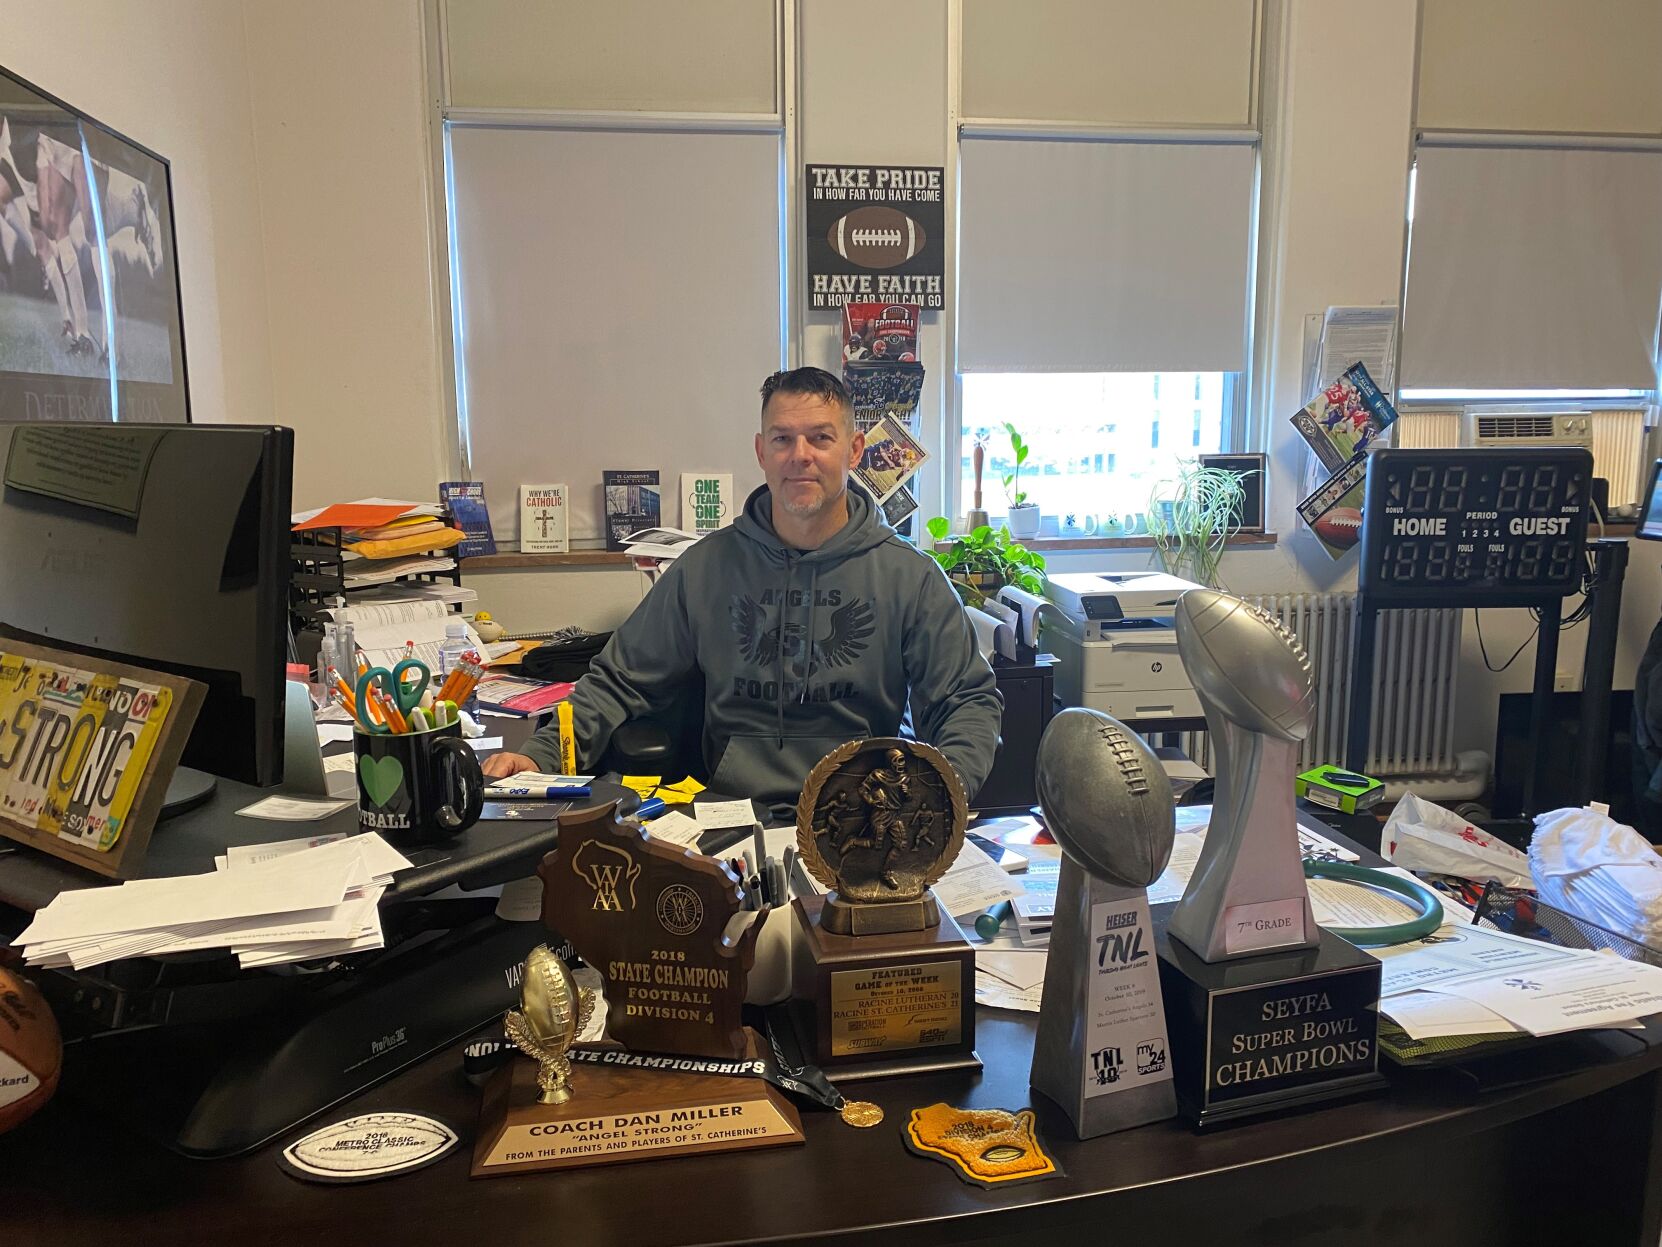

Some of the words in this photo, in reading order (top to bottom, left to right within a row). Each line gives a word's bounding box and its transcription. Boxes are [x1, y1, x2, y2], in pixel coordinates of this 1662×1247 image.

[812, 168, 871, 188] TAKE
[875, 169, 941, 189] PRIDE
[814, 188, 822, 200] IN
[826, 188, 846, 200] HOW
[849, 189, 866, 200] FAR
[869, 189, 885, 200] YOU
[888, 189, 912, 201] HAVE
[915, 190, 940, 201] COME
[813, 275, 871, 293] HAVE
[878, 275, 941, 293] FAITH
[814, 294, 824, 306] IN
[827, 294, 851, 306] HOW
[903, 294, 924, 306] CAN
[928, 295, 941, 306] GO
[695, 479, 719, 493] ONE
[527, 497, 562, 507] CATHOLIC
[695, 494, 719, 504] TEAM
[696, 505, 720, 519] ONE
[1385, 506, 1404, 514] BONUS
[1466, 511, 1498, 520] PERIOD
[1393, 518, 1447, 536] HOME
[1462, 529, 1467, 537] 1
[1509, 517, 1571, 535] GUEST
[1457, 545, 1473, 553] FOULS
[1488, 544, 1504, 552] FOULS
[1106, 911, 1138, 928] HEISER
[1255, 917, 1292, 931] GRADE
[1096, 928, 1149, 967] TNL
[651, 951, 685, 961] 2018
[609, 961, 650, 983] STATE
[655, 964, 729, 989] CHAMPION
[872, 968, 922, 979] FEATURED
[855, 980, 882, 990] GAME
[911, 976, 939, 985] WEEK
[629, 988, 711, 1005] FOOTBALL
[858, 999, 893, 1008] RACINE
[895, 993, 947, 1004] LUTHERAN
[626, 1004, 700, 1020] DIVISION
[705, 1011, 714, 1024] 4
[1262, 993, 1332, 1021] SEYFA
[834, 1010, 868, 1019] RACINE
[1232, 1029, 1296, 1054] SUPER
[1302, 1018, 1358, 1041] BOWL
[1137, 1044, 1154, 1056] my
[1150, 1049, 1165, 1065] 24
[603, 1051, 766, 1075] CHAMPIONSHIPS
[1091, 1048, 1123, 1070] TNL
[1216, 1039, 1370, 1086] CHAMPIONS
[1138, 1063, 1165, 1073] SPORTS
[529, 1120, 603, 1137] COACH
[614, 1114, 660, 1128] DAN
[671, 1106, 743, 1122] MILLER
[952, 1121, 975, 1129] 2018
[945, 1126, 985, 1136] DIVISION
[336, 1139, 369, 1147] METRO
[372, 1136, 414, 1145] CLASSIC
[505, 1151, 534, 1161] FROM
[537, 1148, 556, 1157] THE
[560, 1143, 602, 1155] PARENTS
[606, 1140, 628, 1151] AND
[631, 1136, 671, 1148] PLAYERS
[675, 1134, 687, 1143] OF
[691, 1132, 704, 1141] ST.
[708, 1126, 767, 1141] CATHERINE'S
